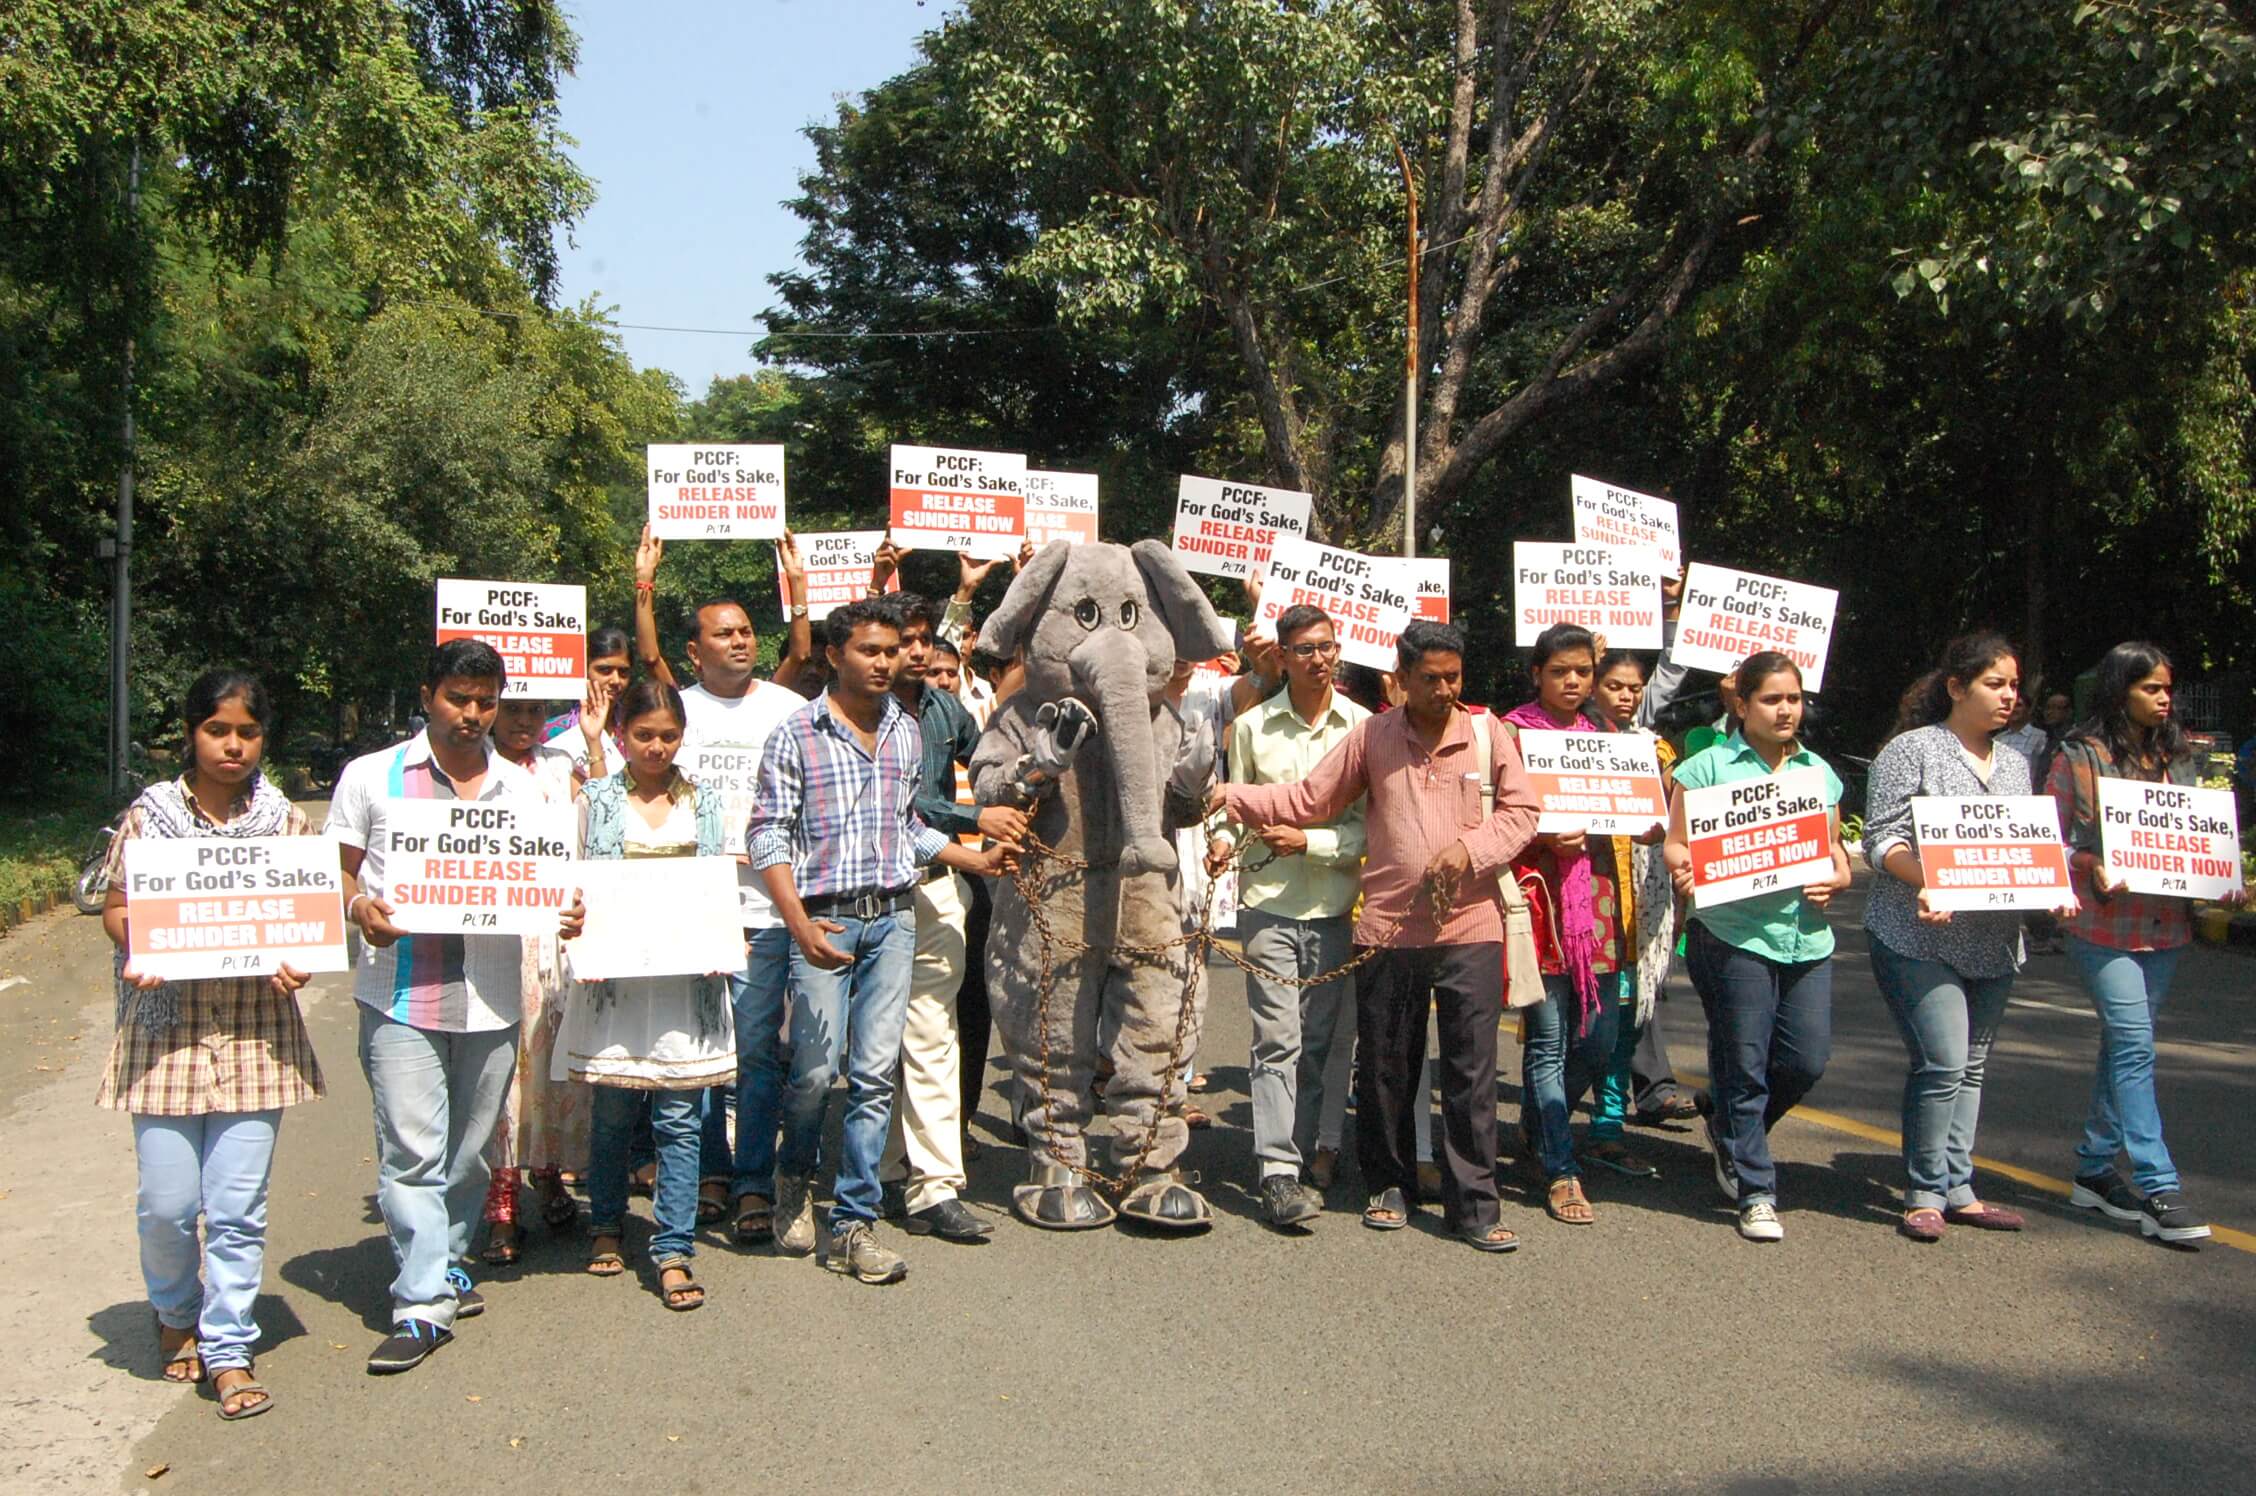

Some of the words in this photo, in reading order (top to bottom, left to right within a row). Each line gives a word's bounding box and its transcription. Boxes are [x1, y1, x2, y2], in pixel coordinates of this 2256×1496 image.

[694, 452, 739, 465] PCCF:
[937, 456, 982, 472] PCCF:
[655, 470, 680, 483] For
[687, 470, 730, 483] God's
[736, 470, 779, 486] Sake,
[896, 470, 922, 484] For
[928, 472, 972, 488] God's
[978, 476, 1021, 494] Sake,
[1026, 478, 1053, 490] CF:
[679, 488, 756, 501] RELEASE
[922, 494, 995, 513] RELEASE
[1050, 494, 1092, 510] Sake,
[1222, 487, 1267, 507] PCCF:
[1607, 490, 1642, 509] PCCF:
[658, 505, 729, 519] SUNDER
[737, 506, 776, 519] NOW
[903, 510, 970, 529] SUNDER
[975, 515, 1014, 532] NOW
[1180, 499, 1206, 515] For
[1211, 504, 1254, 523] God's
[1260, 511, 1302, 534] Sake,
[1577, 496, 1597, 510] For
[1602, 503, 1636, 522] God's
[1641, 513, 1674, 535] Sake,
[1597, 516, 1657, 542] RELEASE
[816, 539, 856, 551] PCCF:
[1178, 536, 1248, 559] SUNDER
[810, 554, 849, 566] God's
[1319, 552, 1371, 579] PCCF:
[1563, 550, 1612, 565] PCCF:
[1271, 561, 1301, 581] For
[1306, 570, 1355, 596] God's
[1360, 584, 1409, 613] Sake,
[1417, 580, 1444, 595] ake,
[1520, 569, 1547, 584] For
[1555, 569, 1601, 585] God's
[1609, 570, 1656, 590] Sake,
[1736, 578, 1787, 601] PCCF:
[488, 590, 538, 607] PCCF:
[1291, 588, 1380, 623] RELEASE
[1546, 589, 1630, 606] RELEASE
[442, 608, 472, 624] For
[479, 609, 527, 626] God's
[534, 612, 581, 632] Sake,
[1524, 609, 1601, 625] SUNDER
[1609, 611, 1653, 626] NOW
[1688, 589, 1717, 607] For
[1723, 596, 1772, 619] God's
[1778, 606, 1827, 634] Sake,
[1350, 624, 1399, 649] NOW
[1710, 613, 1798, 644] RELEASE
[1683, 629, 1763, 656] SUNDER
[532, 657, 573, 674] NOW
[1566, 738, 1612, 753] PCCF:
[699, 754, 752, 770] PCCF:
[1528, 754, 1554, 768] For
[1560, 755, 1604, 770] God's
[1610, 757, 1655, 774] Sake,
[1558, 777, 1632, 795] RELEASE
[1731, 783, 1780, 806] PCCF:
[2144, 789, 2191, 809] PCCF:
[451, 808, 515, 829] PCCF:
[1691, 818, 1719, 835] For
[1725, 805, 1771, 827] God's
[1777, 796, 1823, 816] Sake,
[1961, 804, 2011, 819] PCCF:
[1920, 824, 1948, 839] For
[1956, 823, 2003, 839] God's
[2009, 824, 2056, 841] Sake,
[2105, 806, 2131, 824] For
[2138, 809, 2183, 830] God's
[2189, 815, 2233, 839] Sake,
[391, 832, 429, 853] For
[438, 833, 501, 855] God's
[509, 836, 570, 861] Sake,
[1721, 824, 1797, 855] RELEASE
[2131, 830, 2211, 855] RELEASE
[198, 847, 270, 866] PCCF:
[1704, 850, 1775, 880] SUNDER
[1779, 840, 1818, 864] NOW
[1953, 848, 2033, 865] RELEASE
[2112, 850, 2184, 873] SUNDER
[2191, 858, 2232, 878] NOW
[133, 873, 175, 892] For
[186, 870, 256, 890] God's
[266, 869, 335, 889] Sake,
[425, 859, 537, 881] RELEASE
[1937, 868, 2010, 885] SUNDER
[2013, 867, 2055, 885] NOW
[394, 884, 497, 906] SUNDER
[507, 887, 565, 907] NOW
[179, 899, 295, 924] RELEASE
[150, 924, 257, 950] SUNDER
[265, 922, 326, 945] NOW
